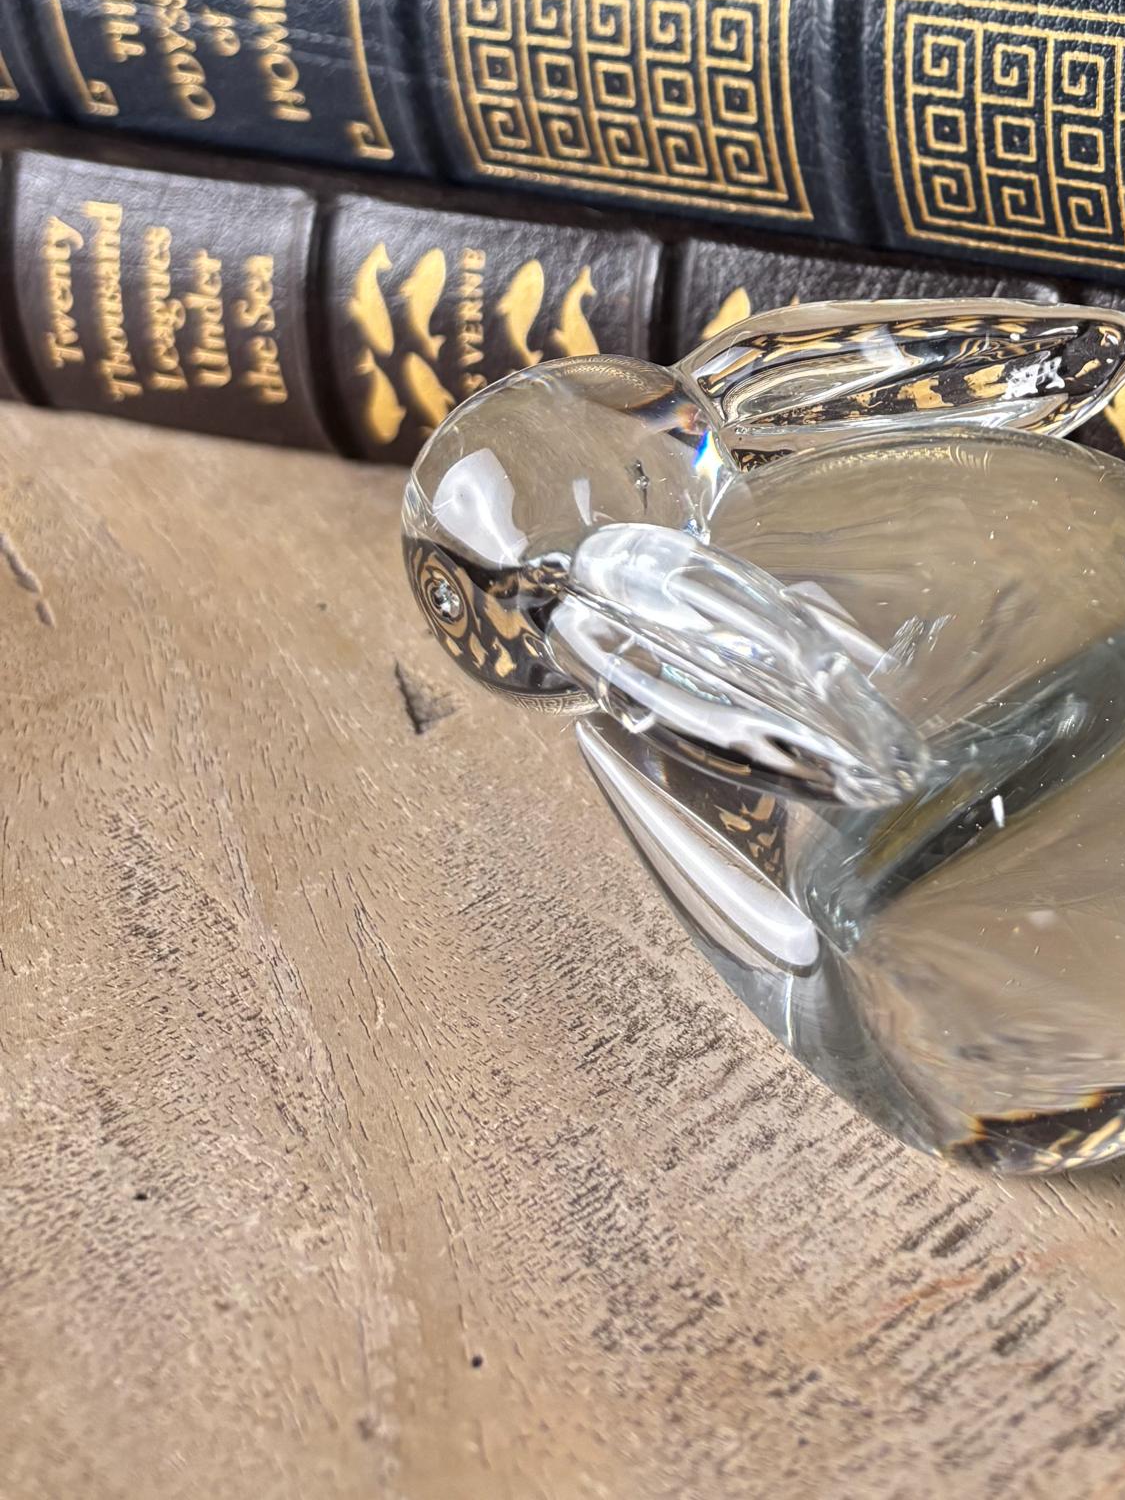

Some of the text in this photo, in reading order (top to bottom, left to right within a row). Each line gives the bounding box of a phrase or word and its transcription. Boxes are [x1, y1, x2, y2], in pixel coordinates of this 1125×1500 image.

[40, 215, 84, 368] Twenty
[79, 200, 144, 402] Thousand
[142, 225, 188, 391] Leagues
[183, 248, 232, 387] Under
[233, 254, 289, 403] the Sea
[457, 246, 486, 367] VERNE
